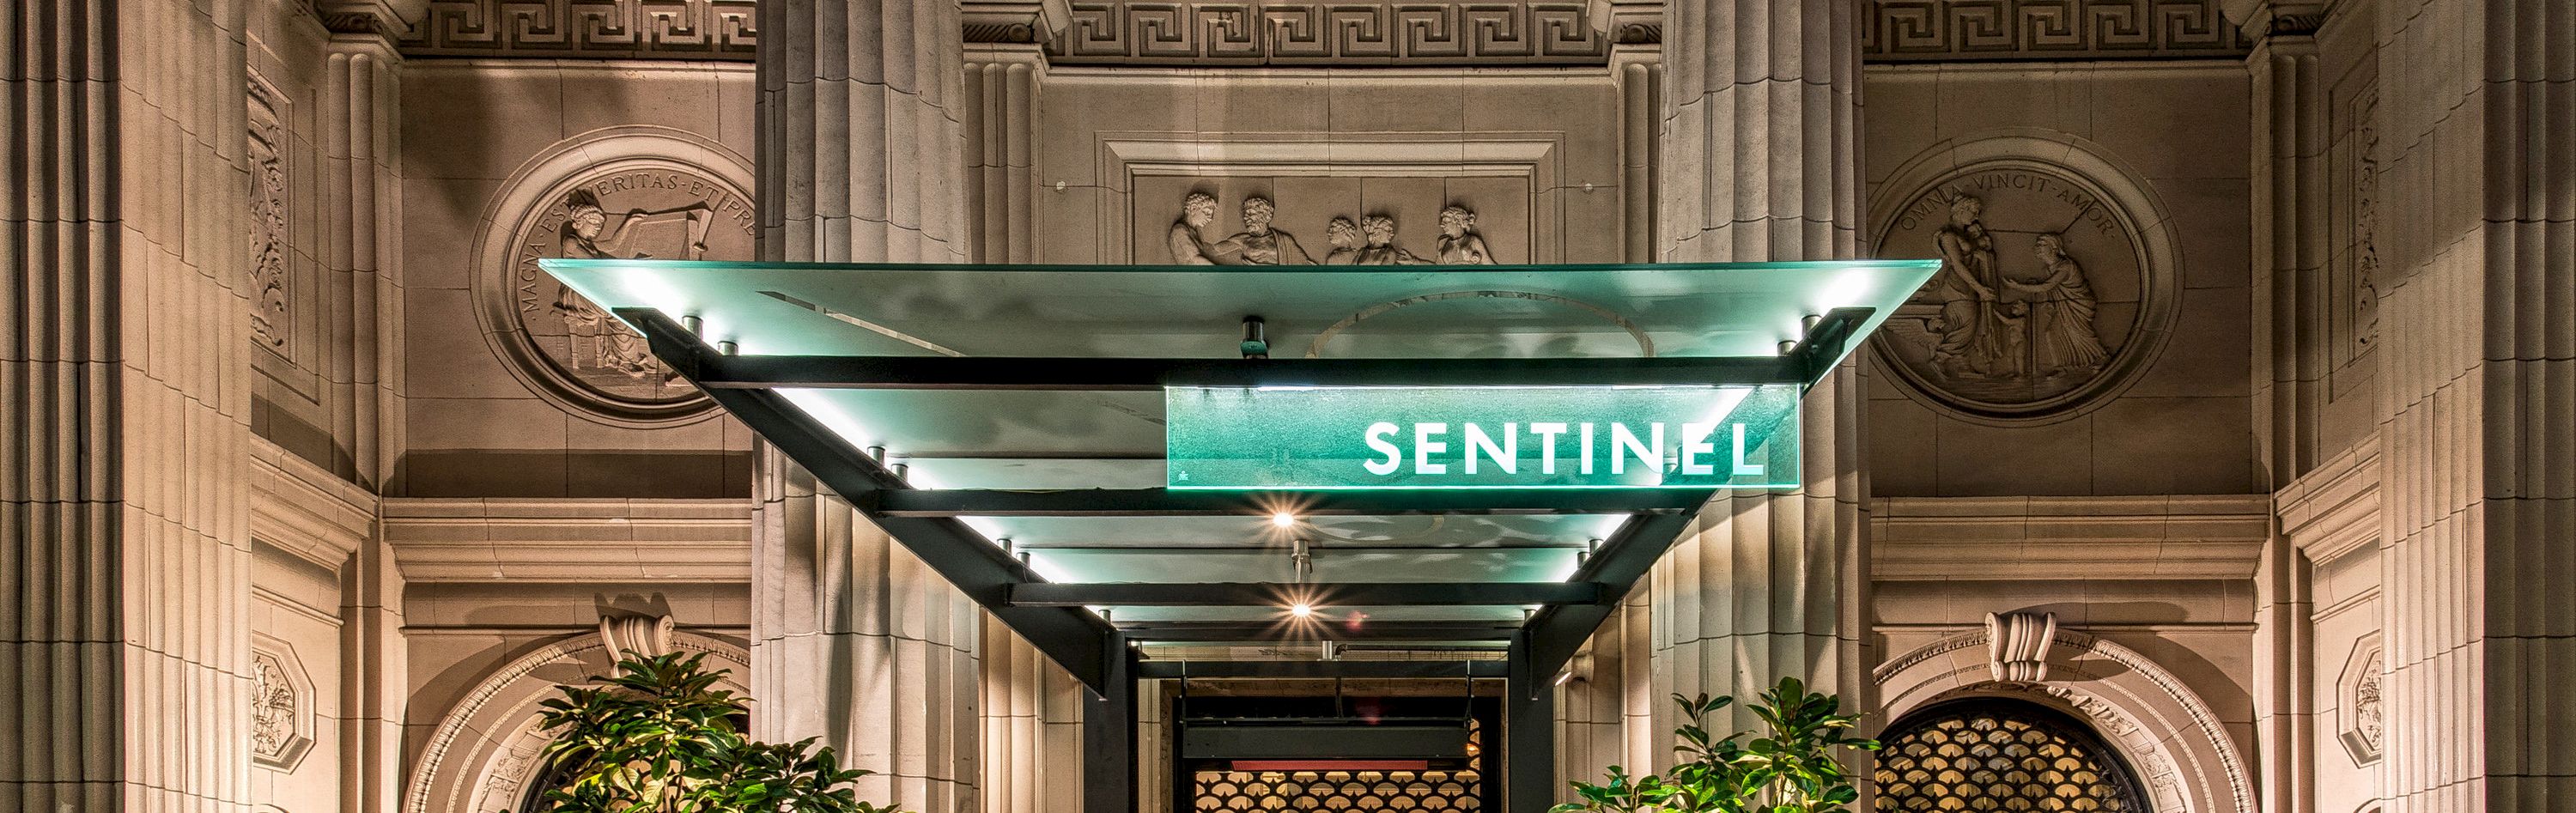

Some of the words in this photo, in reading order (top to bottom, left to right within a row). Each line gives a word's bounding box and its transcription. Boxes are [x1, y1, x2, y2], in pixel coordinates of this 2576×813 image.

[1901, 184, 1964, 231] OMNIA
[1971, 173, 2050, 191] VINCIT
[521, 242, 546, 314] MAGNA
[581, 173, 678, 200] VERITAS
[688, 179, 720, 202] ET
[1363, 422, 1765, 476] SENTINEL
